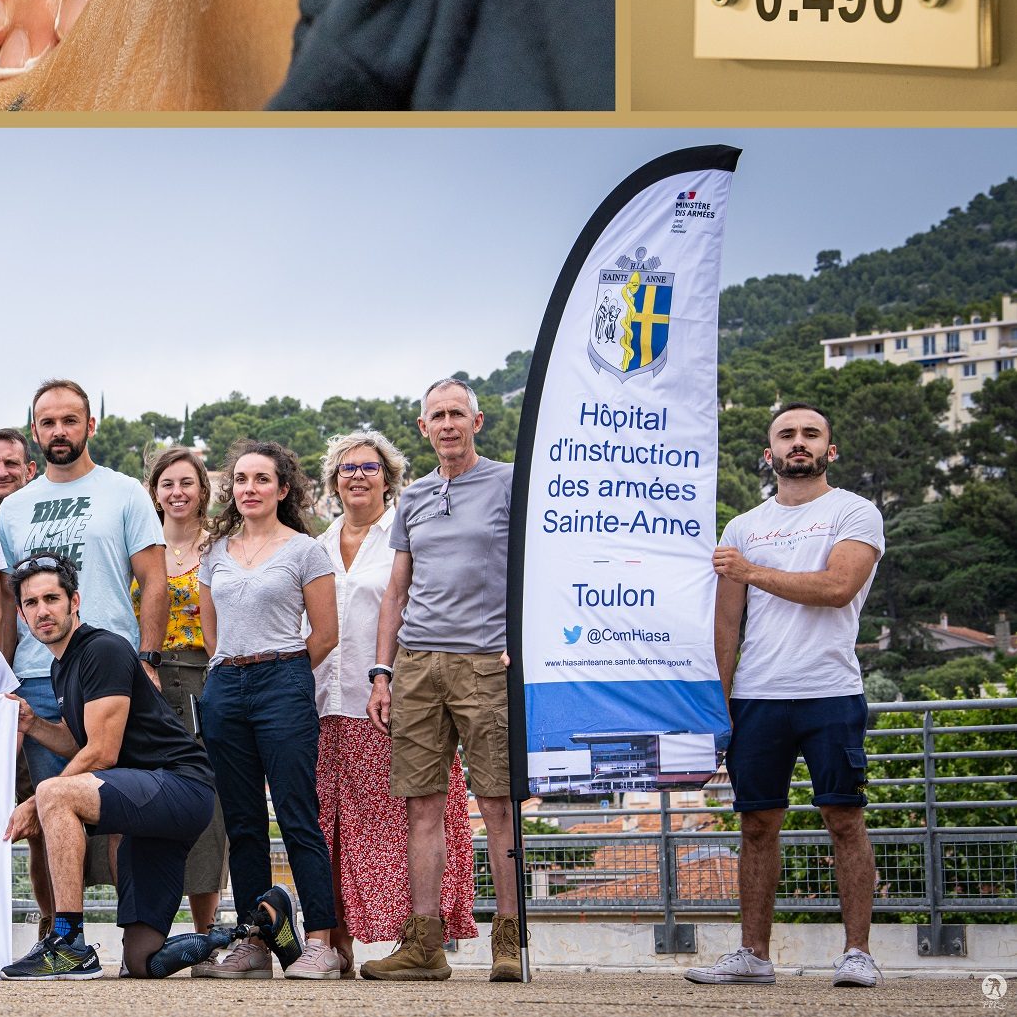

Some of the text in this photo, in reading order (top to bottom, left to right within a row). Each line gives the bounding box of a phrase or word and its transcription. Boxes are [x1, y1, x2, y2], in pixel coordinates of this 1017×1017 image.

[686, 209, 716, 219] ARMÉES
[602, 273, 667, 284] SAINTE ANNE
[580, 402, 667, 433] Hôpital
[549, 438, 700, 469] d'instruction
[548, 474, 697, 502] des armées
[542, 508, 702, 538] Sainte-Anne
[572, 582, 655, 607] Toulon
[587, 628, 671, 645] @ComHiasa
